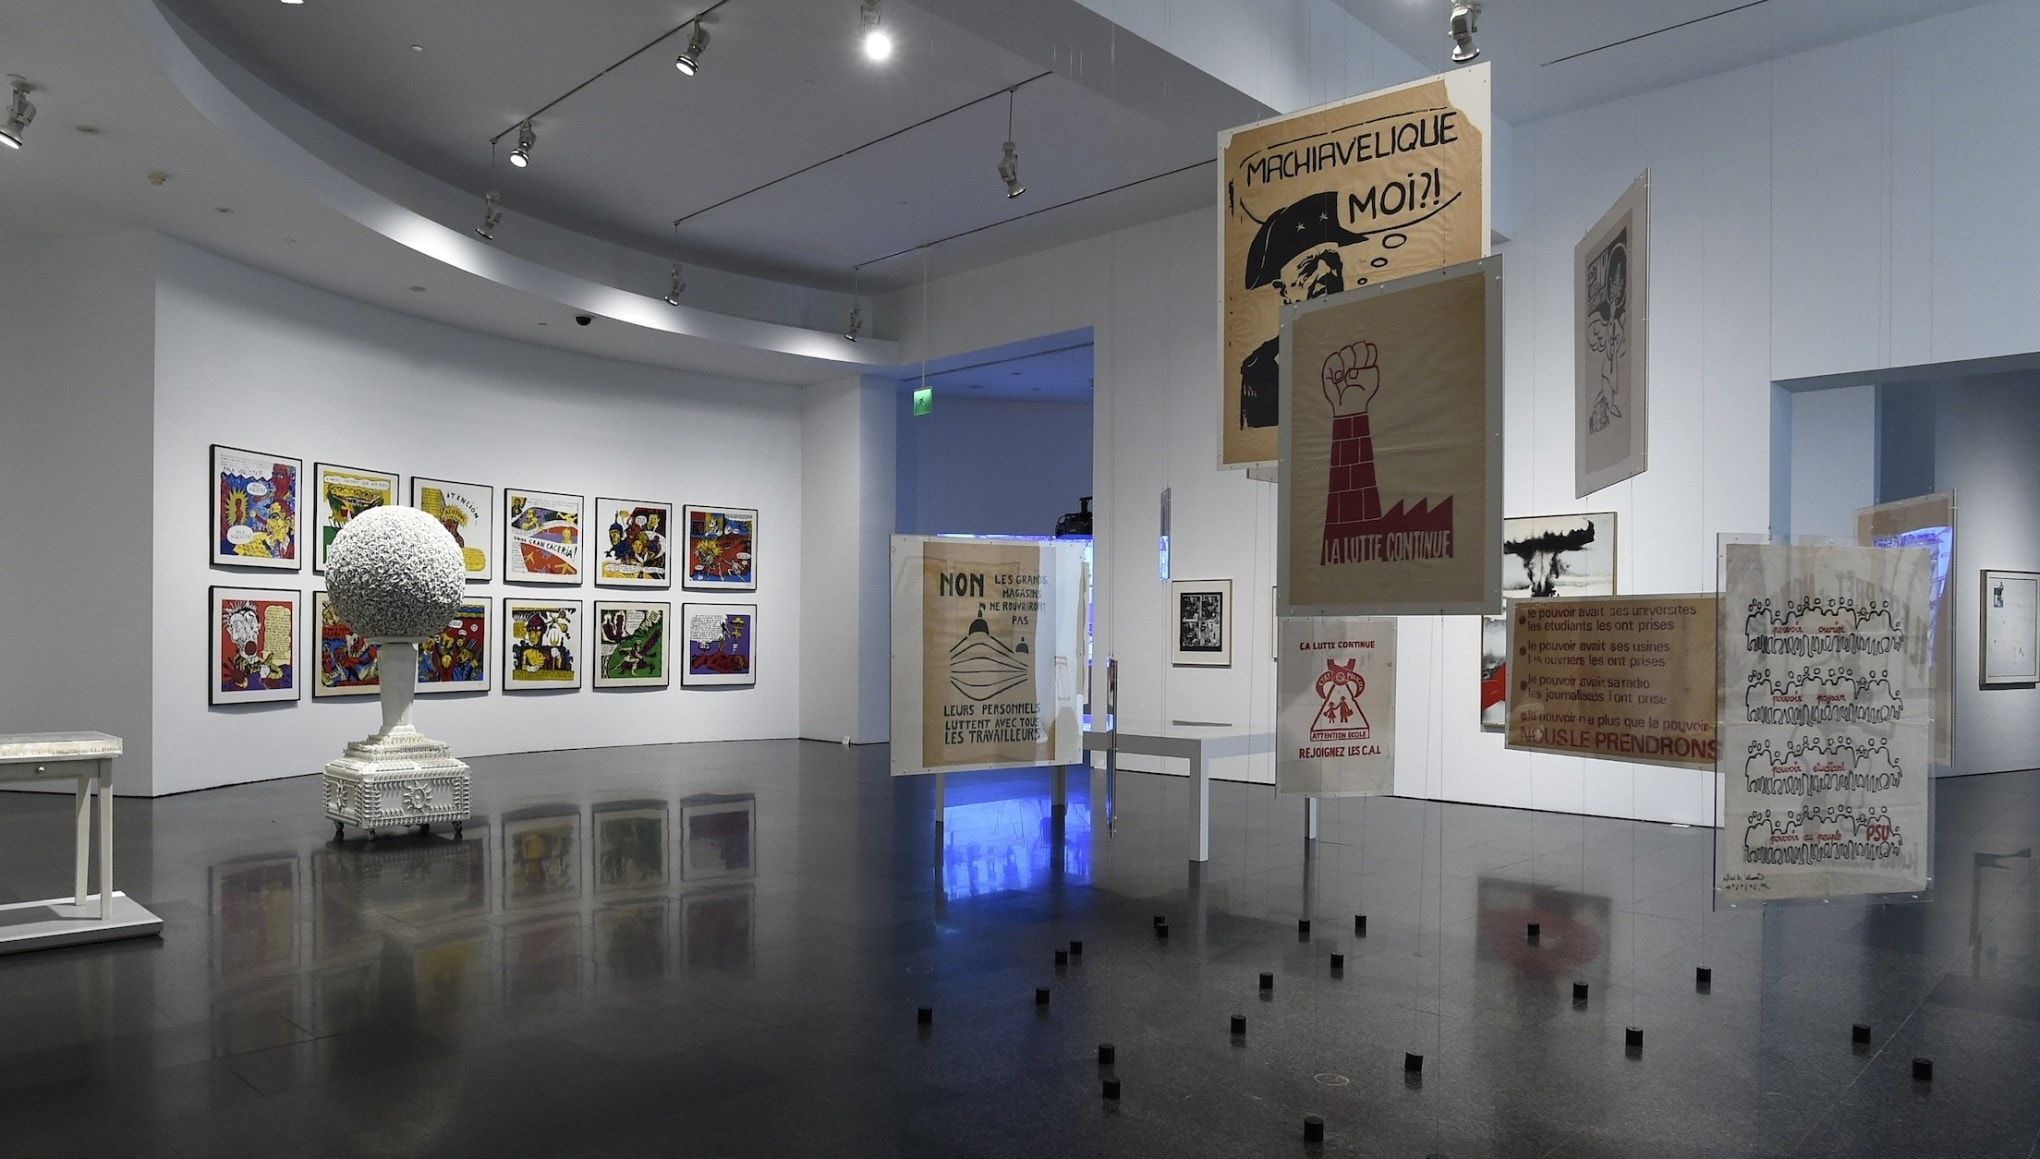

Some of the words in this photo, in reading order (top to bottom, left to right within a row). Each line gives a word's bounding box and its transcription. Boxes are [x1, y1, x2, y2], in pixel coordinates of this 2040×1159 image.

[1247, 111, 1458, 187] MACHIAVELIQUE
[1325, 538, 1342, 566] LA
[1344, 534, 1383, 564] LUTTE
[1386, 530, 1451, 562] CONTINUE
[940, 572, 984, 597] NON
[995, 574, 1014, 584] LES
[1002, 588, 1042, 598] MAGASINS
[990, 602, 1000, 612] NE
[1002, 602, 1046, 612] ROUVRIRONT
[1528, 608, 1536, 618] le
[1539, 606, 1575, 621] pouvoir
[1578, 607, 1604, 618] avait
[1610, 607, 1629, 616] ses
[1012, 616, 1029, 626] PAS
[1528, 620, 1542, 632] les
[1596, 620, 1612, 631] les
[1614, 620, 1634, 631] ont
[1638, 618, 1674, 632] prises
[1313, 642, 1336, 650] LUTTE
[1338, 640, 1375, 648] CONTINUE
[1528, 640, 1537, 650] le
[1539, 640, 1576, 652] pouvoir
[1580, 640, 1606, 651] avait
[1610, 642, 1630, 652] ses
[1633, 640, 1670, 652] usines
[1528, 654, 1542, 664] ls
[1544, 656, 1585, 666] ouvriers
[1588, 654, 1604, 666] les
[1608, 656, 1626, 666] ont
[1630, 656, 1666, 668] prises
[1528, 674, 1536, 684] le
[1539, 675, 1576, 688] pouvoir
[1528, 688, 1542, 699] les
[1545, 688, 1604, 702] journalistes
[944, 704, 974, 716] LEURS
[982, 703, 1041, 715] PERSONNELS
[945, 719, 990, 731] LUTTENT
[994, 718, 1018, 728] AVEC
[1528, 710, 1536, 721] le
[1539, 712, 1576, 724] pouvoir
[1598, 714, 1620, 728] plus
[1624, 717, 1645, 729] que
[1649, 716, 1660, 728] le
[1662, 718, 1709, 732] pouvoir
[945, 730, 964, 744] LES
[968, 728, 1041, 744] TRAVAILLEURS
[1570, 730, 1590, 748] LE
[1596, 732, 1721, 759] PRENDRONS
[1299, 746, 1345, 758] REJOIGNEZ
[1348, 746, 1360, 756] LES
[1866, 824, 1890, 842] PSU
